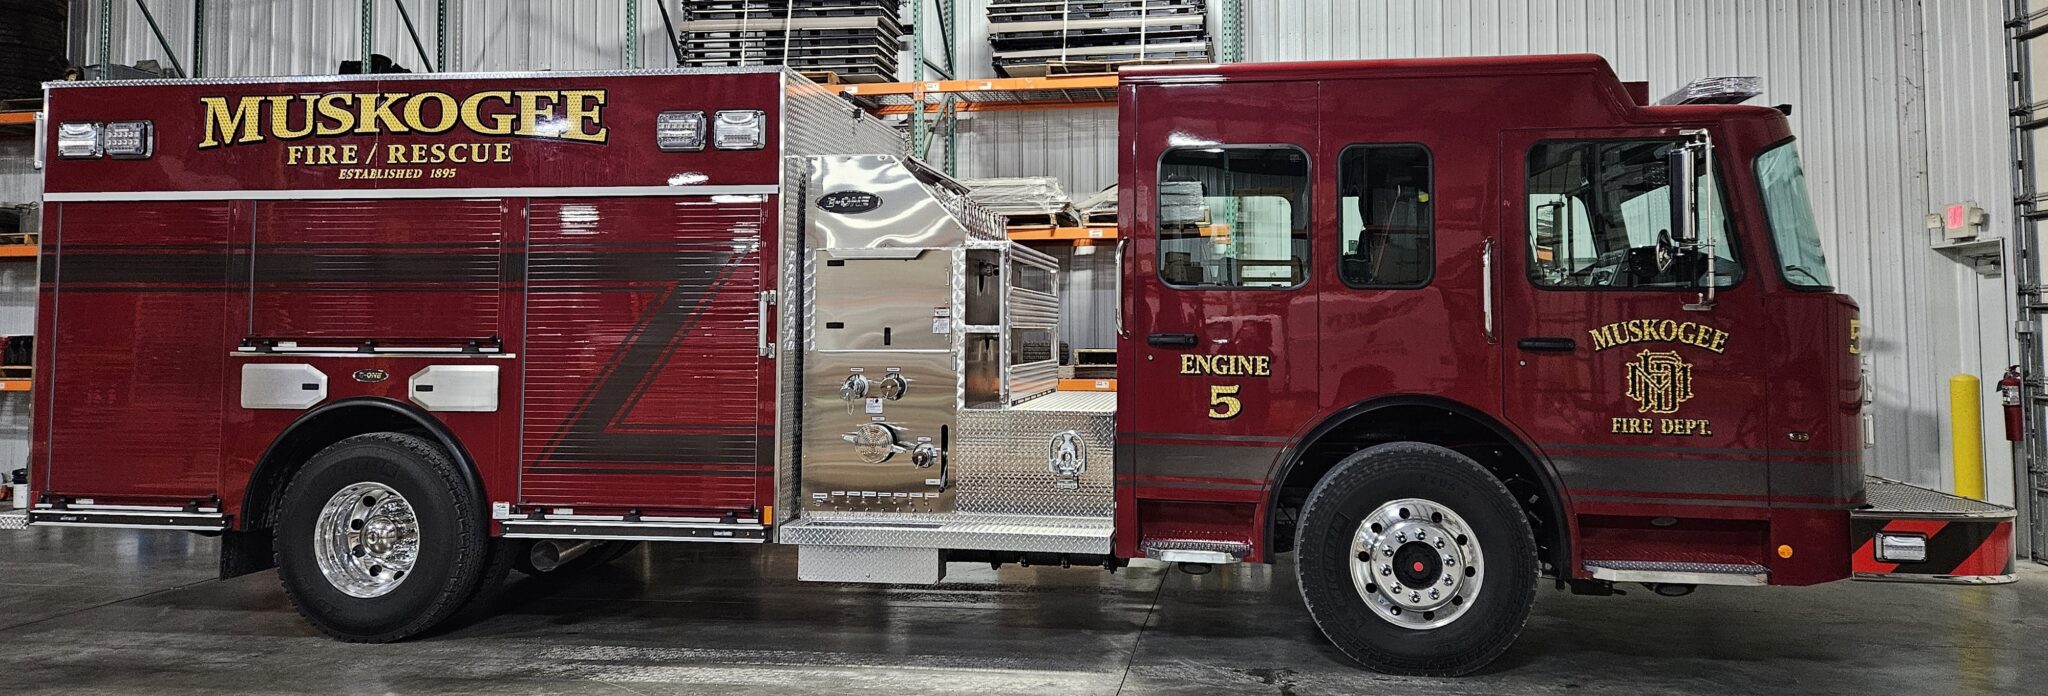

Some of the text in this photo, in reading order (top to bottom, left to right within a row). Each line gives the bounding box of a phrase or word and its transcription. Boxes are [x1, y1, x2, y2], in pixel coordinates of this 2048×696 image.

[199, 90, 608, 147] MUSKOGEE
[288, 144, 359, 166] FIRE
[387, 142, 512, 165] RESCUE
[338, 167, 457, 180] ESTABLISHED 1895
[1588, 319, 1730, 354] MUSKOGEE
[1180, 353, 1271, 376] ENGINE
[1208, 384, 1242, 419] 5
[1611, 417, 1713, 436] FIRE DEPT.
